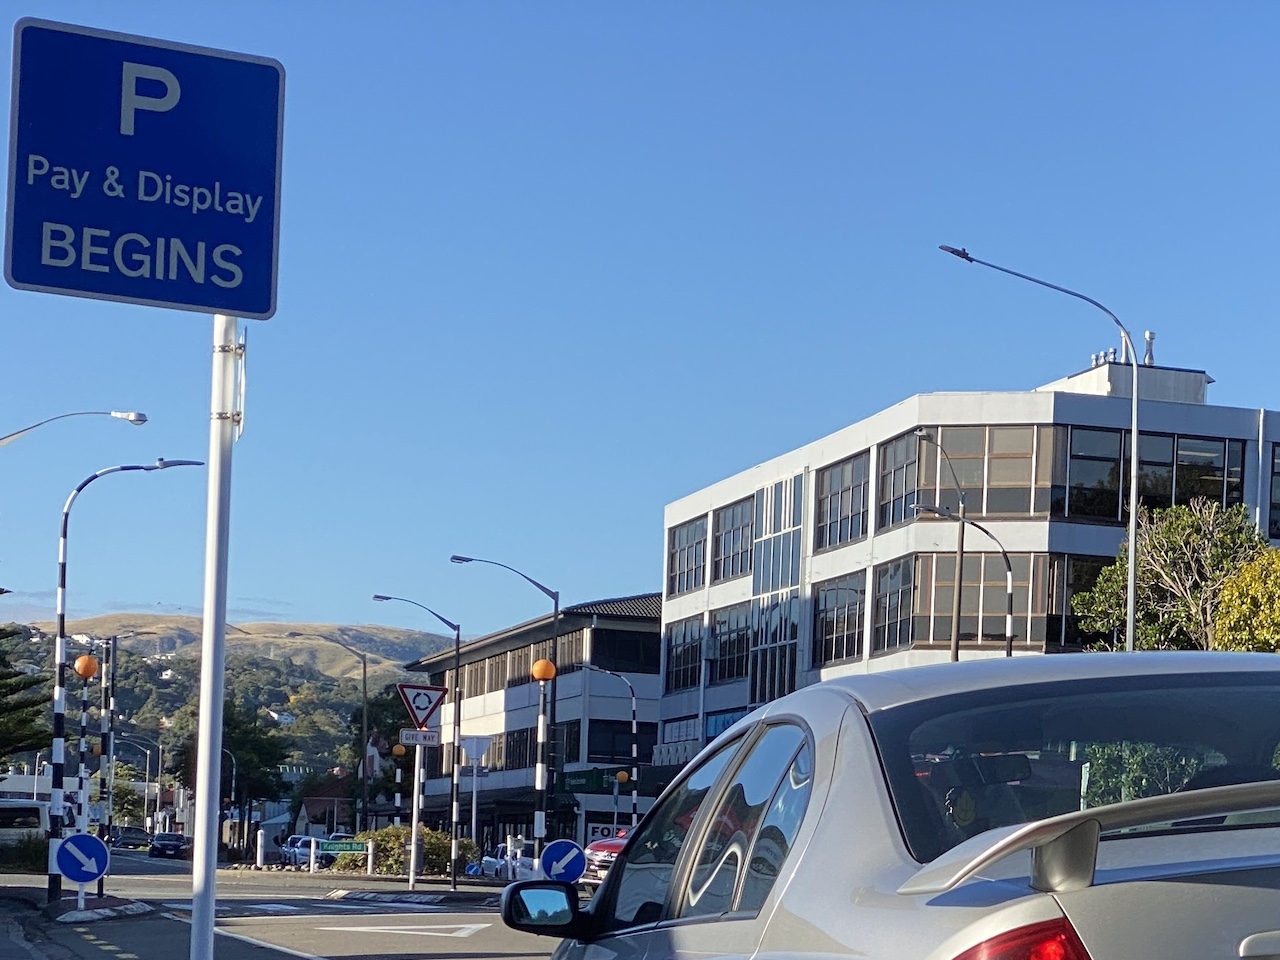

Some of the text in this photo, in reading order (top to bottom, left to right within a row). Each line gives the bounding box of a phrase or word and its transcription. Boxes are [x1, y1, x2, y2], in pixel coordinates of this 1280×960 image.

[120, 61, 181, 135] P
[27, 154, 263, 222] Pay & Display
[41, 221, 243, 288] BEGINS
[405, 733, 435, 742] GIVE WAY
[323, 842, 362, 851] Knights Rd
